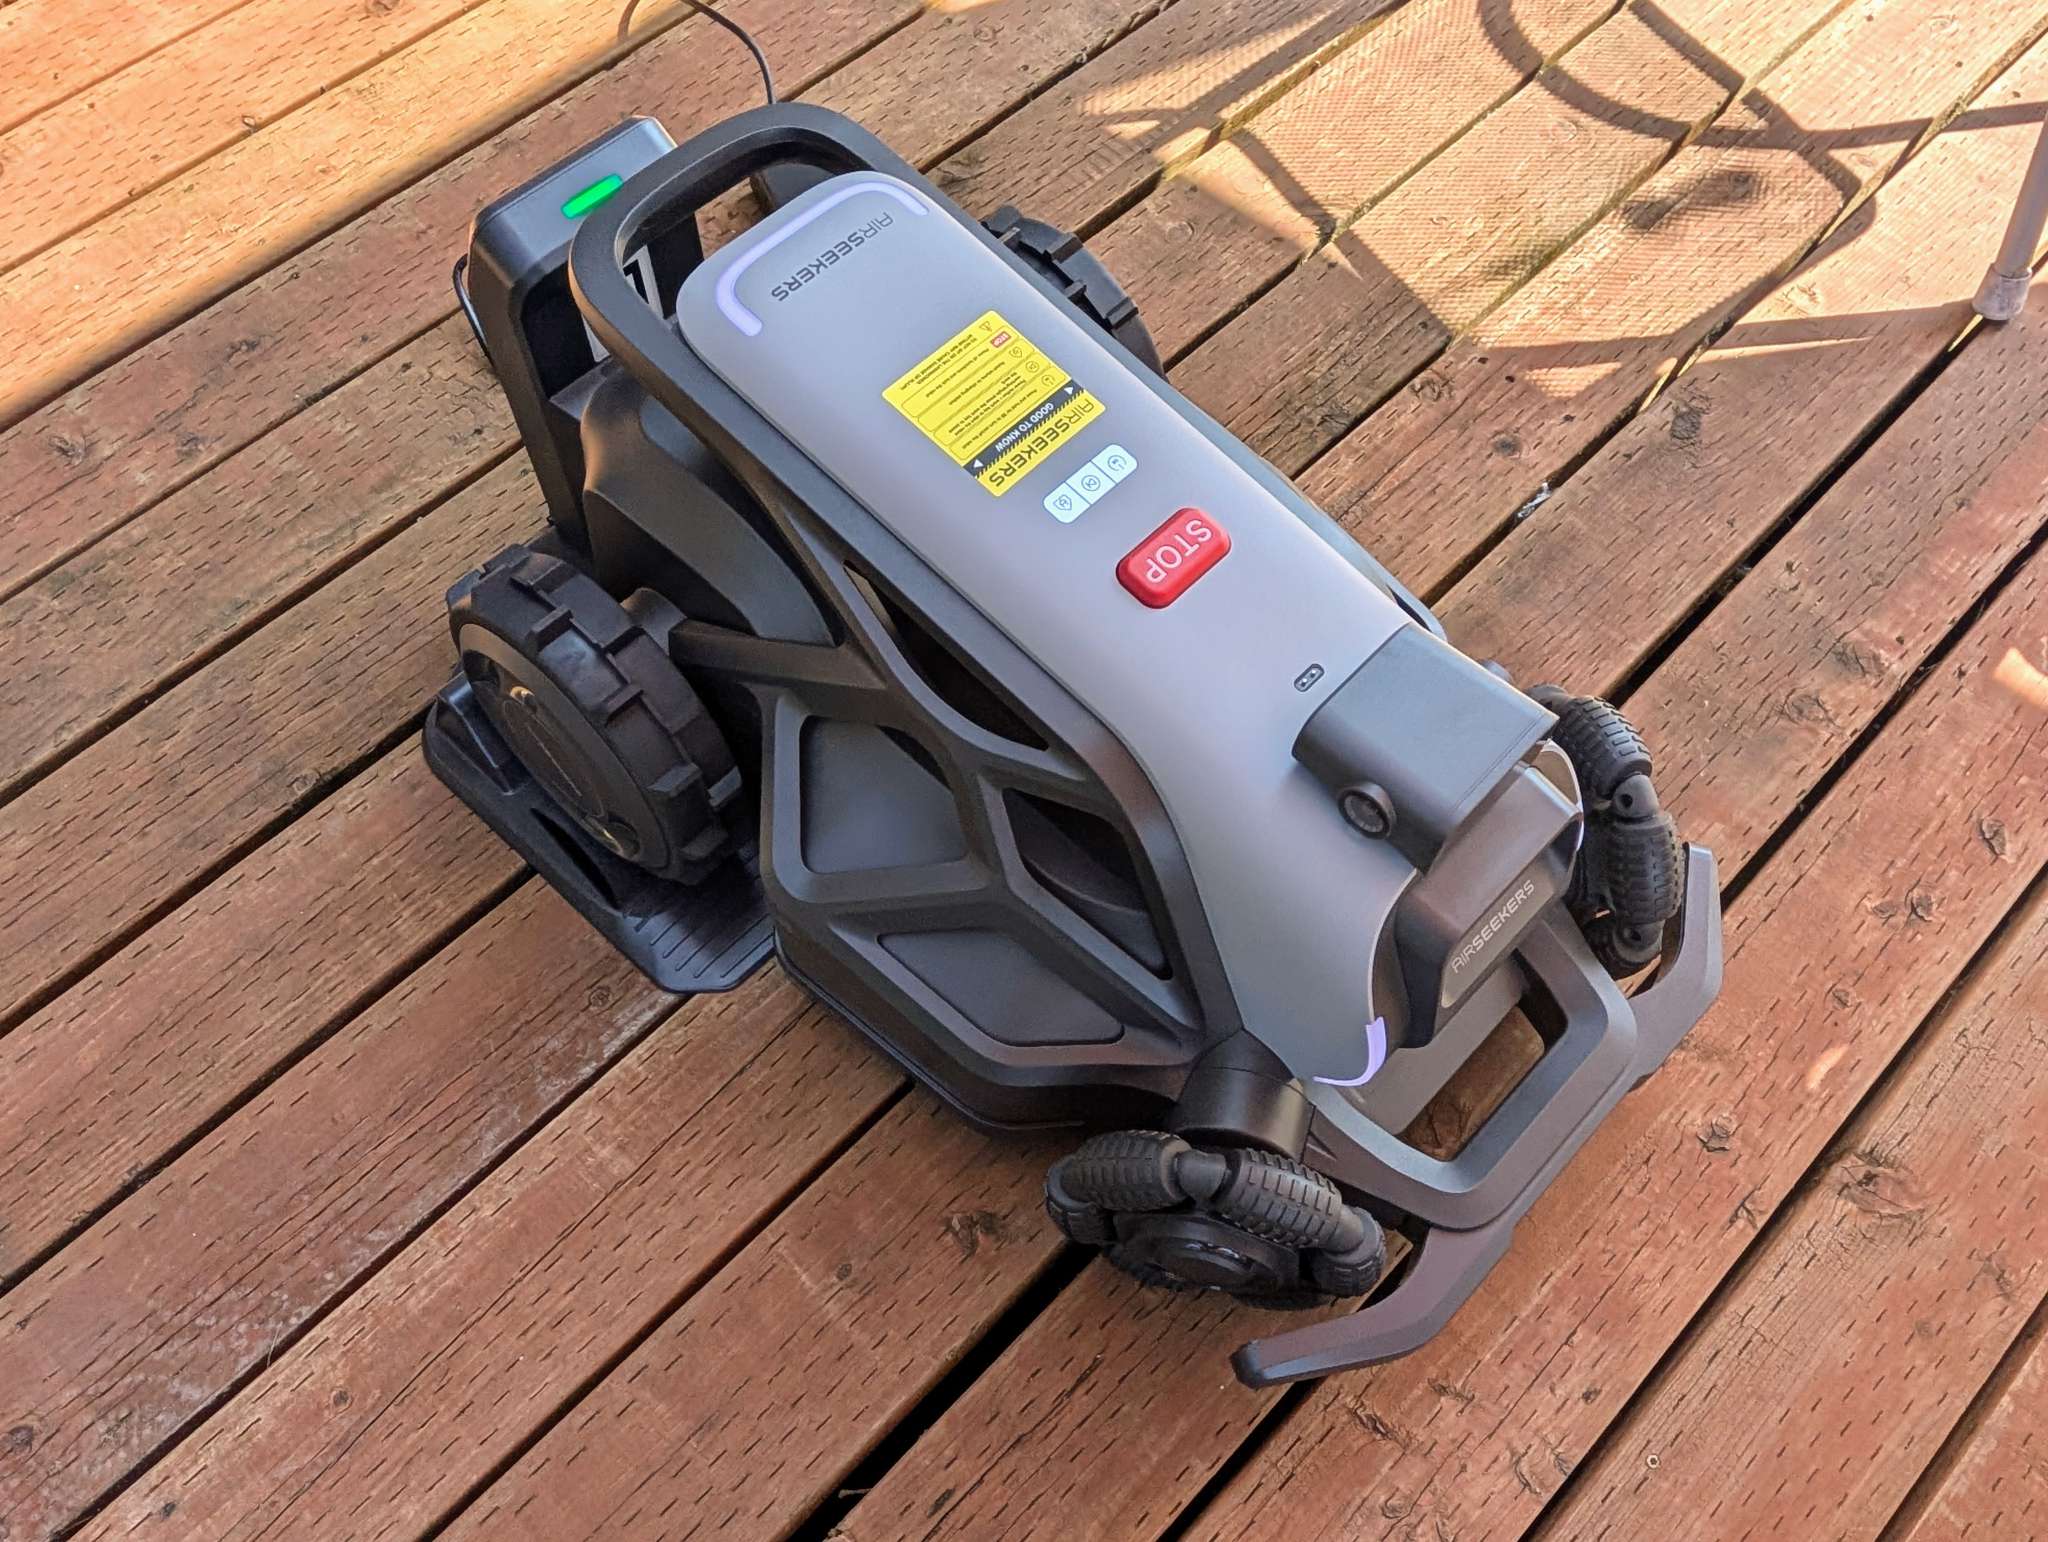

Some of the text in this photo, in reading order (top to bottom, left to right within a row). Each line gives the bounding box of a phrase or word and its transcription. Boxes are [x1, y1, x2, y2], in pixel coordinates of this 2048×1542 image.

[771, 212, 894, 301] AIRSEEKERS
[989, 399, 1095, 487] AIRSEEKERS
[995, 402, 1054, 452] GOOD TO KNOW
[1146, 519, 1212, 583] STOP
[1452, 880, 1535, 973] AIRSEEKERS
